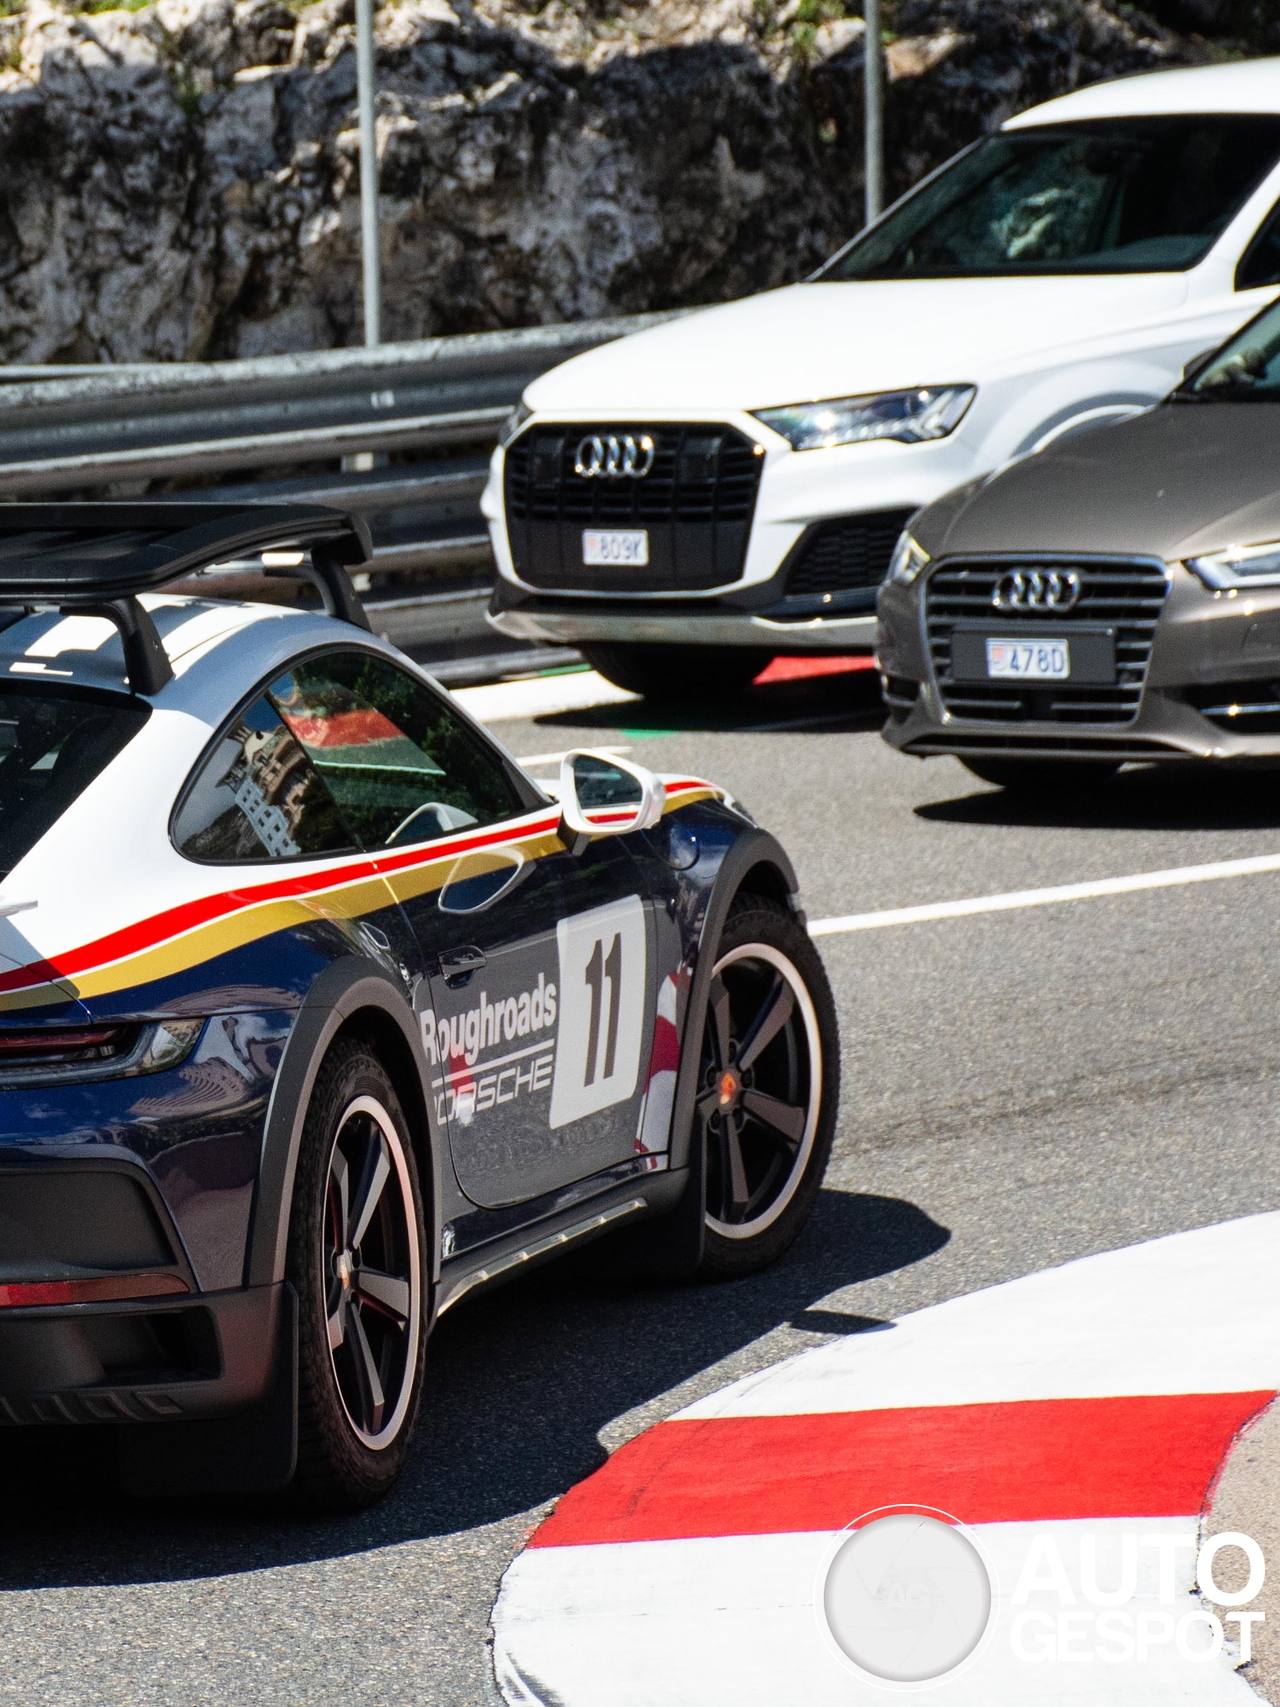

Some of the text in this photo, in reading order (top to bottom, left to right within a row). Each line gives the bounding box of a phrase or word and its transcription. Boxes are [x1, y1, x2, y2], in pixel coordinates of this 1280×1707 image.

[1010, 647, 1065, 673] 478D
[420, 973, 557, 1066] Roughroads
[584, 932, 622, 1087] 11
[434, 1054, 554, 1126] ORSCHE
